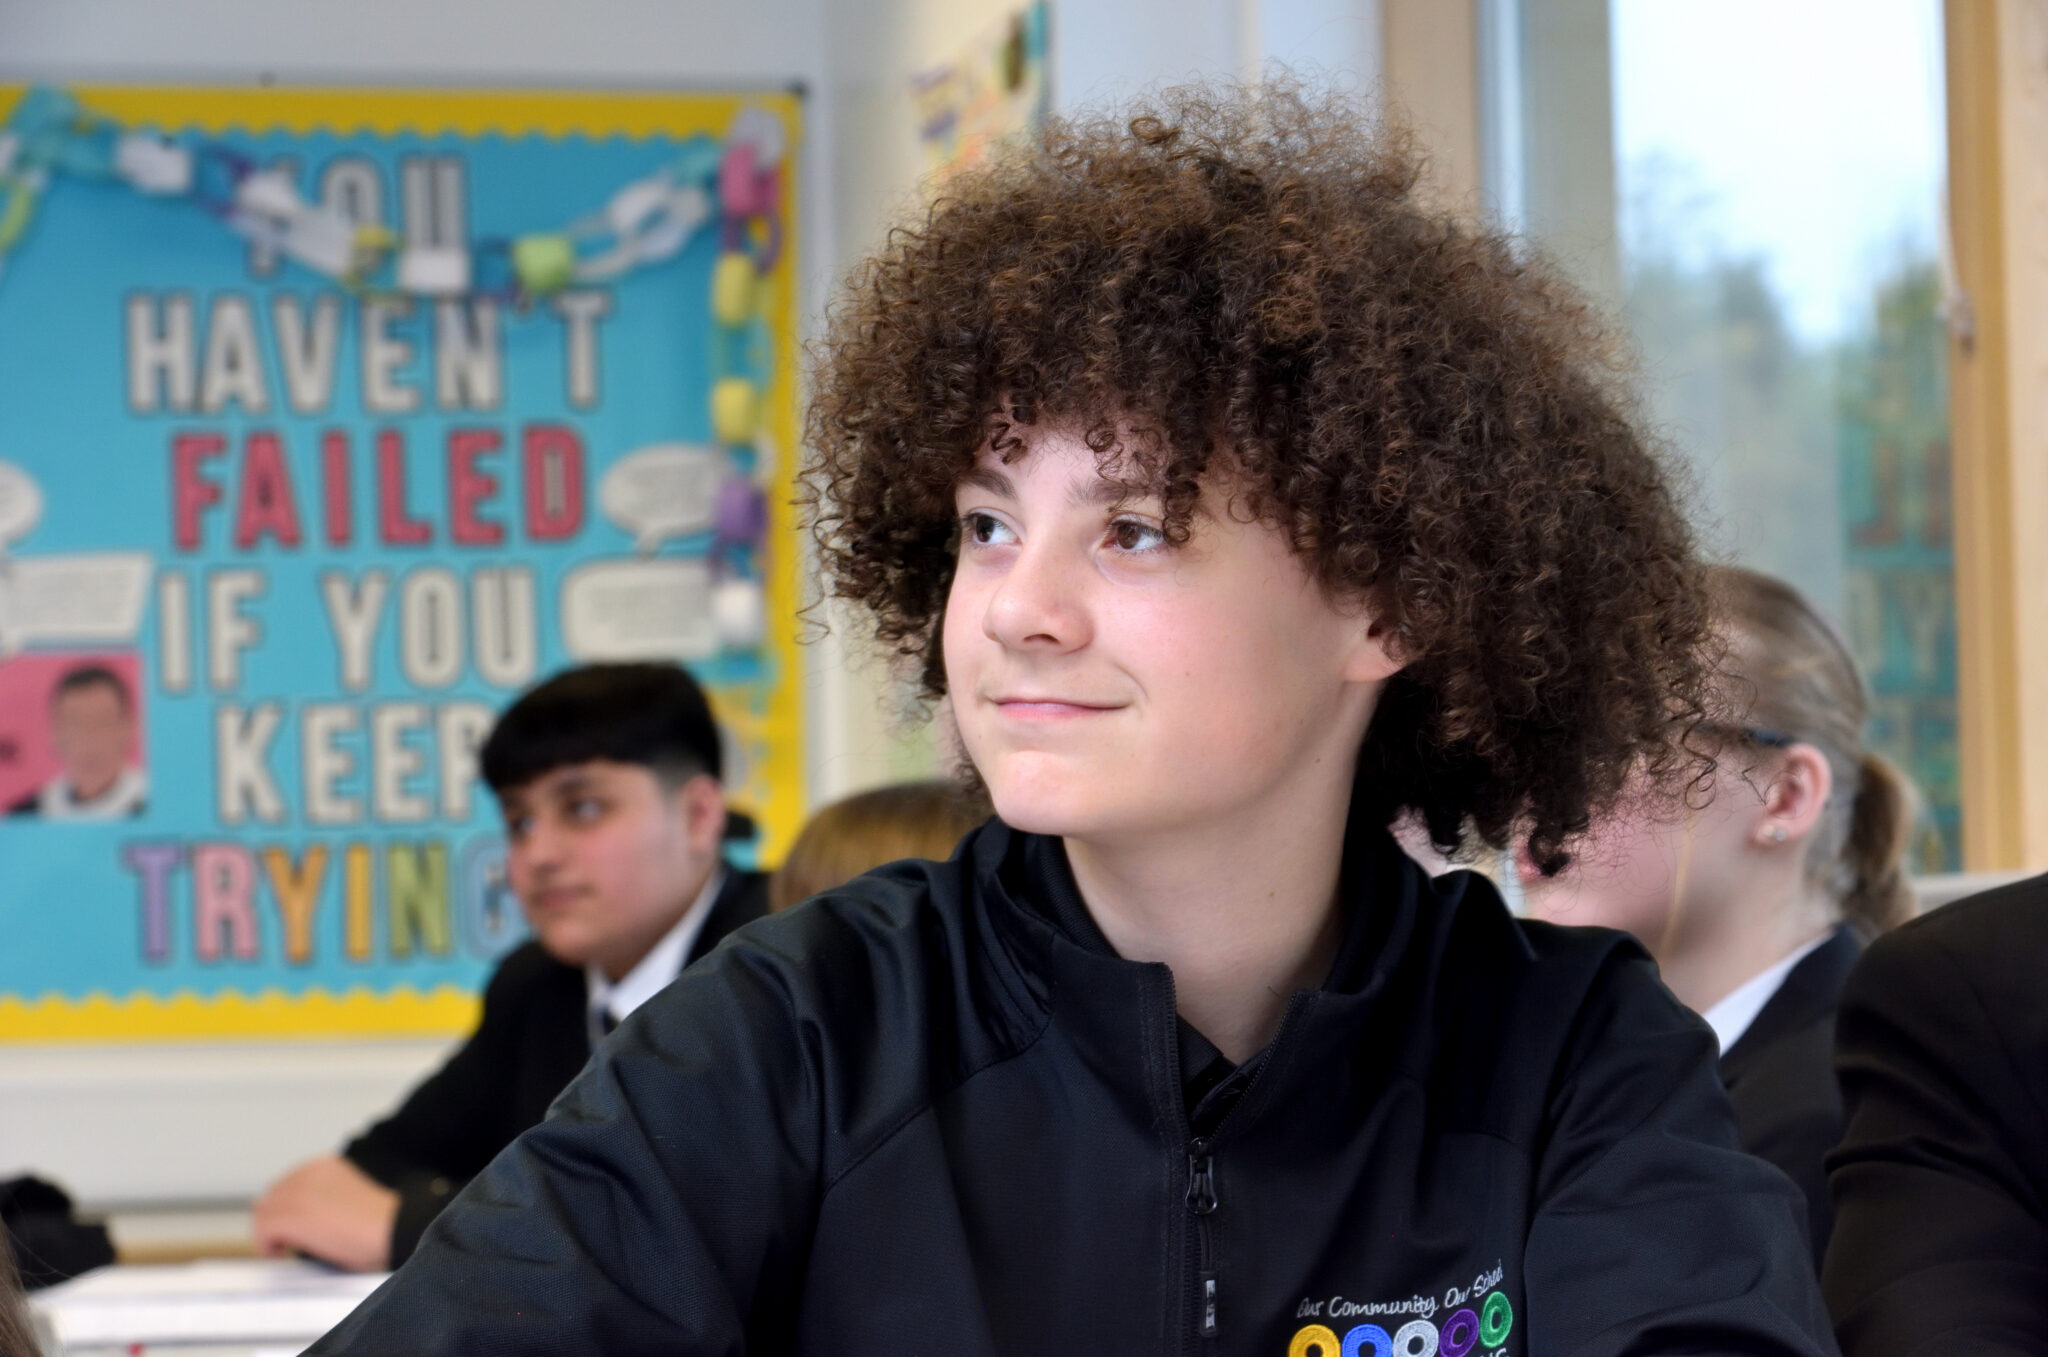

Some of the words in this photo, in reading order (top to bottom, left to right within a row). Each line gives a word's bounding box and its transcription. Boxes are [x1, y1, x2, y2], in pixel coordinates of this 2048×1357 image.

[124, 290, 612, 413] HAVEN'T
[171, 424, 587, 552] FAILED
[158, 570, 264, 692] IF
[319, 566, 538, 690] YOU
[217, 700, 495, 824] KEEP
[125, 840, 528, 964] TRYING
[1297, 1298, 1325, 1319] Our
[1327, 1295, 1440, 1320] Community
[1443, 1287, 1472, 1310] Our
[1472, 1257, 1505, 1299] School
